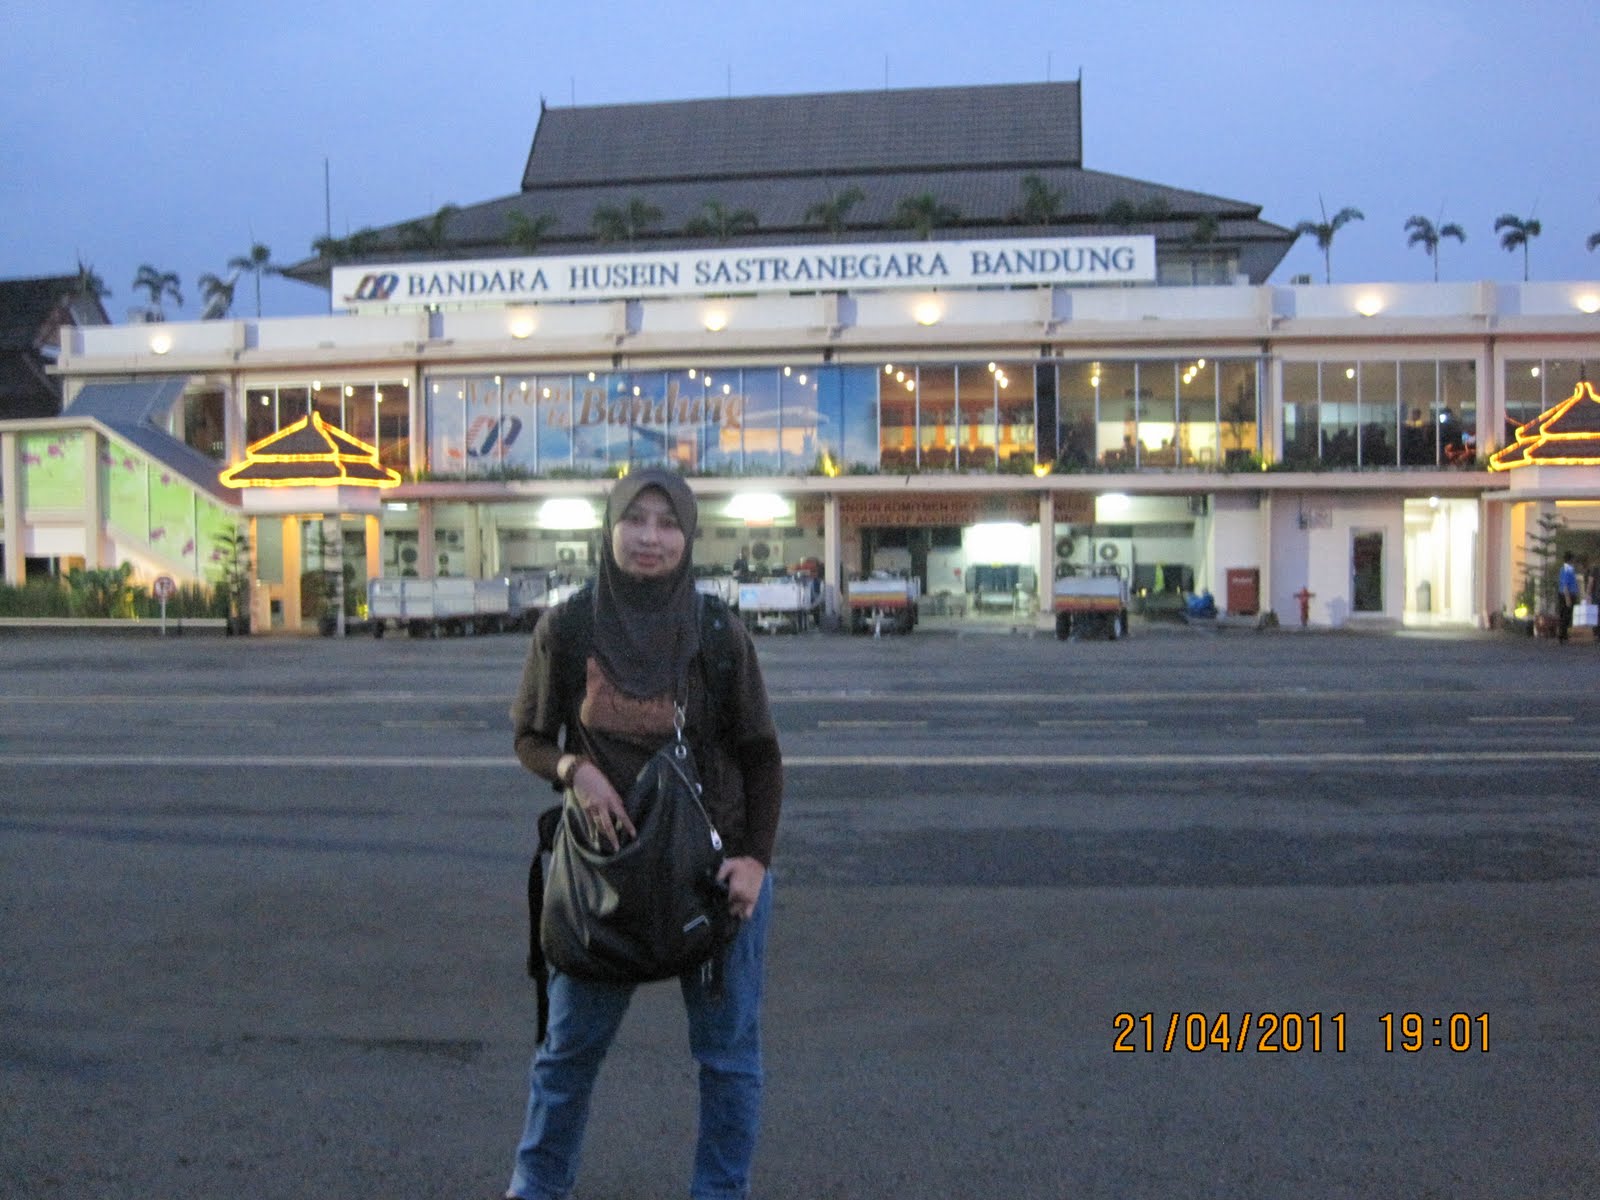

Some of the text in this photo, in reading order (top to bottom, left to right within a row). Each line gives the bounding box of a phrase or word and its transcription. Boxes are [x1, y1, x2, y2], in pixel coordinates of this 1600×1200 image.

[408, 246, 1136, 296] BANDARA HUSEIN SASTRANEGARA BANDUNG
[579, 379, 745, 428] Bandung
